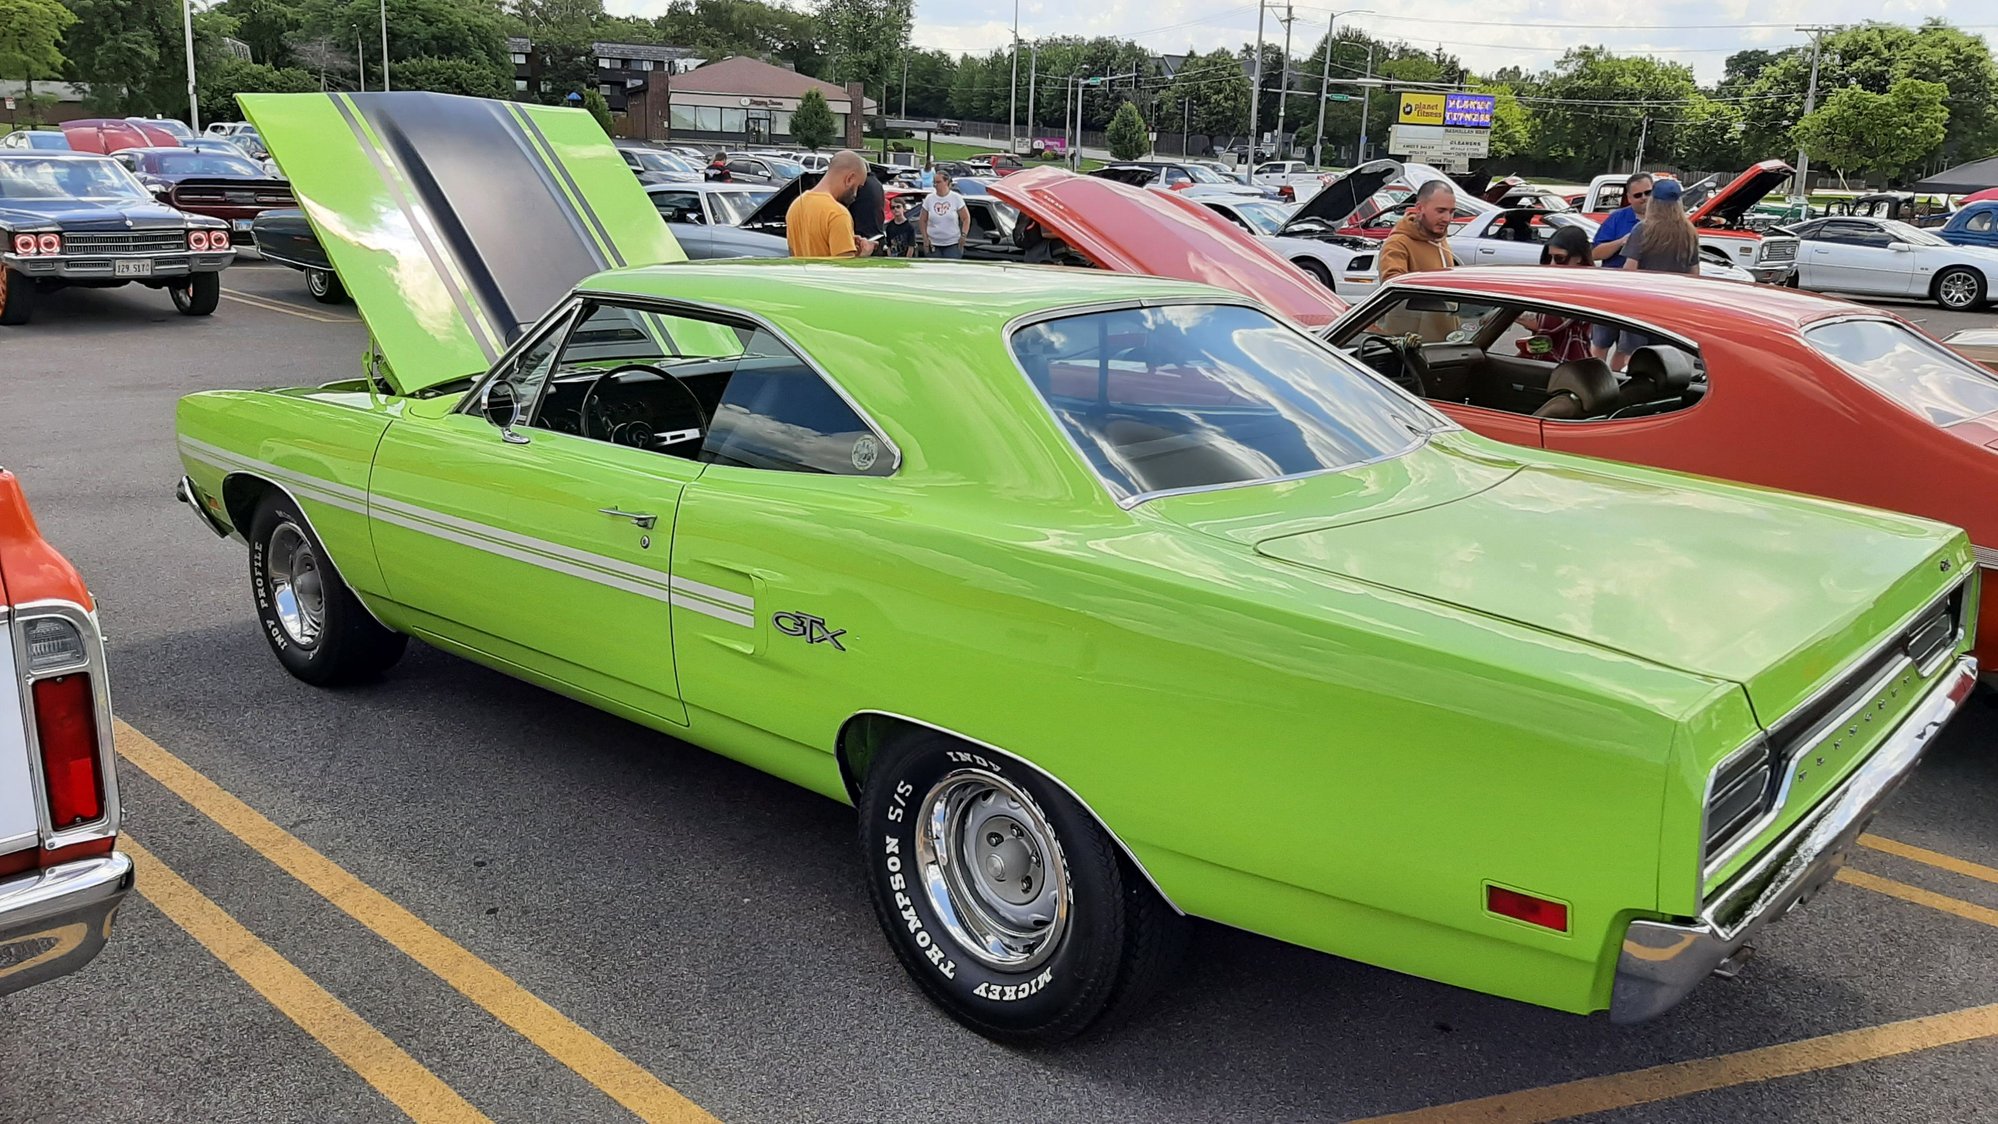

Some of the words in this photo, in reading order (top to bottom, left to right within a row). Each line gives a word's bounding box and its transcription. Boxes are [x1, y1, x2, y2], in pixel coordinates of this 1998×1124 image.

[1414, 102, 1438, 110] planet
[1416, 110, 1442, 118] fitness
[253, 541, 269, 609] PROFILE
[265, 618, 288, 651] INDY
[772, 611, 847, 652] GTX
[946, 751, 1001, 773] INDY
[887, 780, 914, 823] S/S
[885, 835, 957, 980] THOMPSON
[973, 966, 1053, 1001] MICKEY
